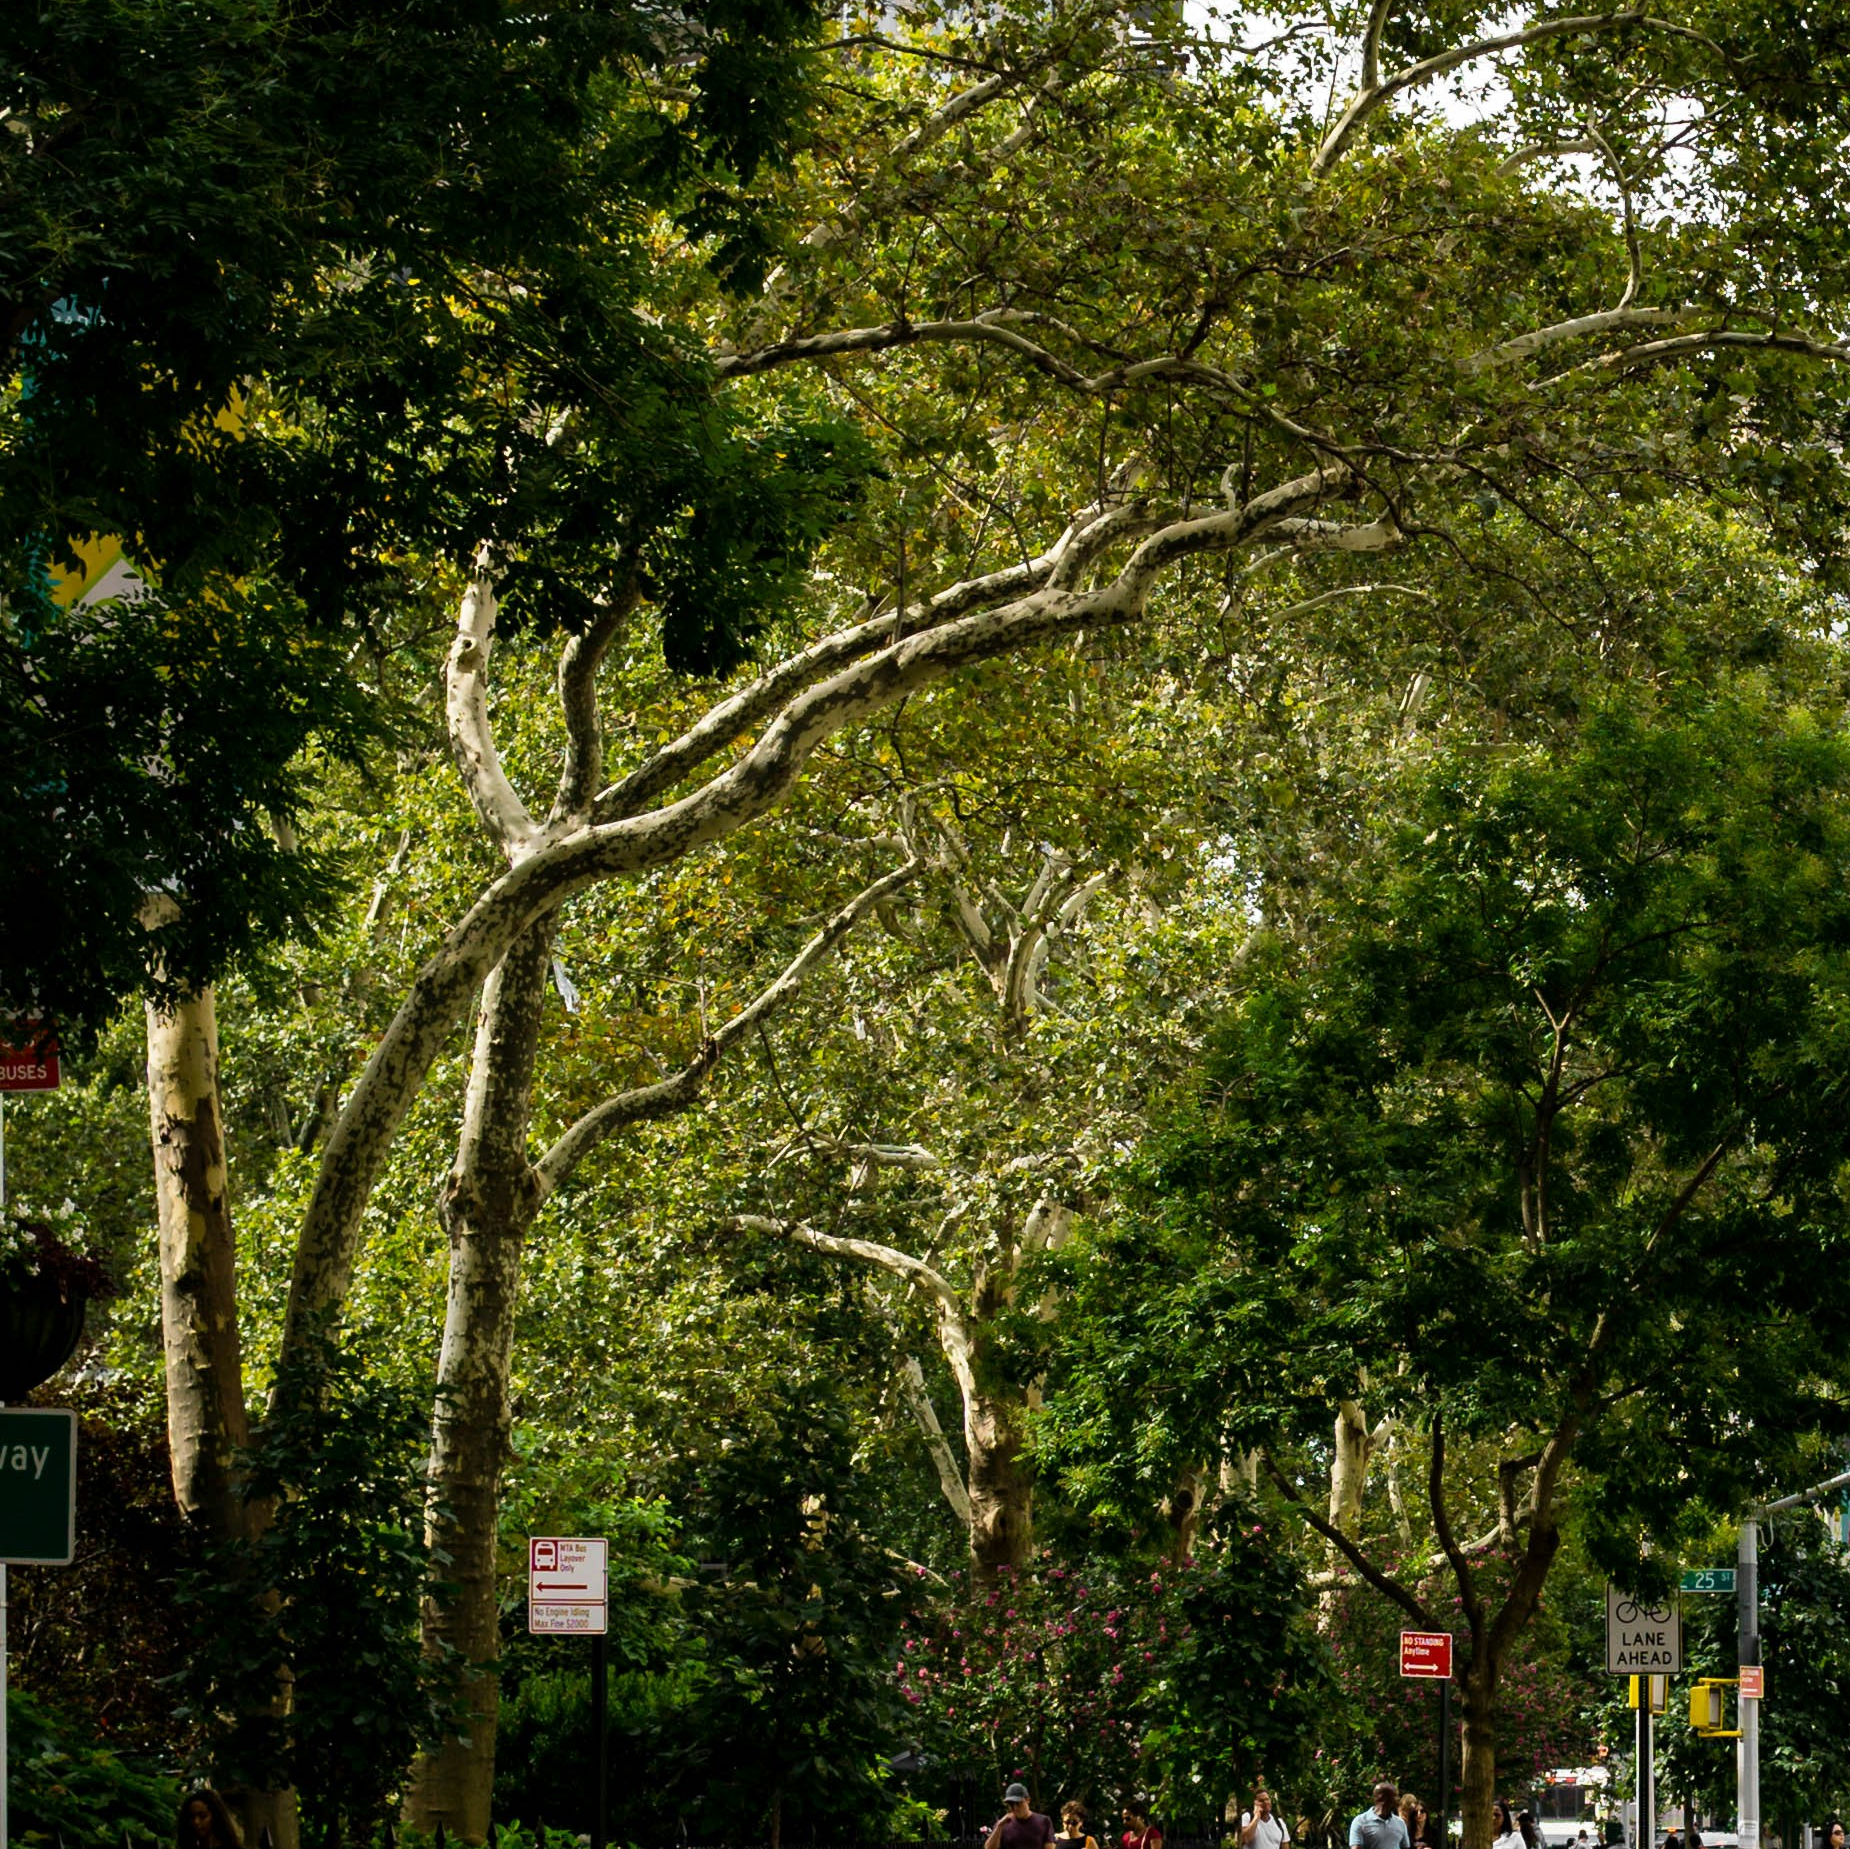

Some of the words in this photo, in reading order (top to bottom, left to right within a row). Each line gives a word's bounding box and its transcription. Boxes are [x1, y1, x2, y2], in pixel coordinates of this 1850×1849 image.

[1695, 1572, 1715, 1589] 25
[1404, 1637, 1413, 1646] NO
[1622, 1632, 1665, 1646] LANE
[1617, 1651, 1672, 1665] AHEAD
